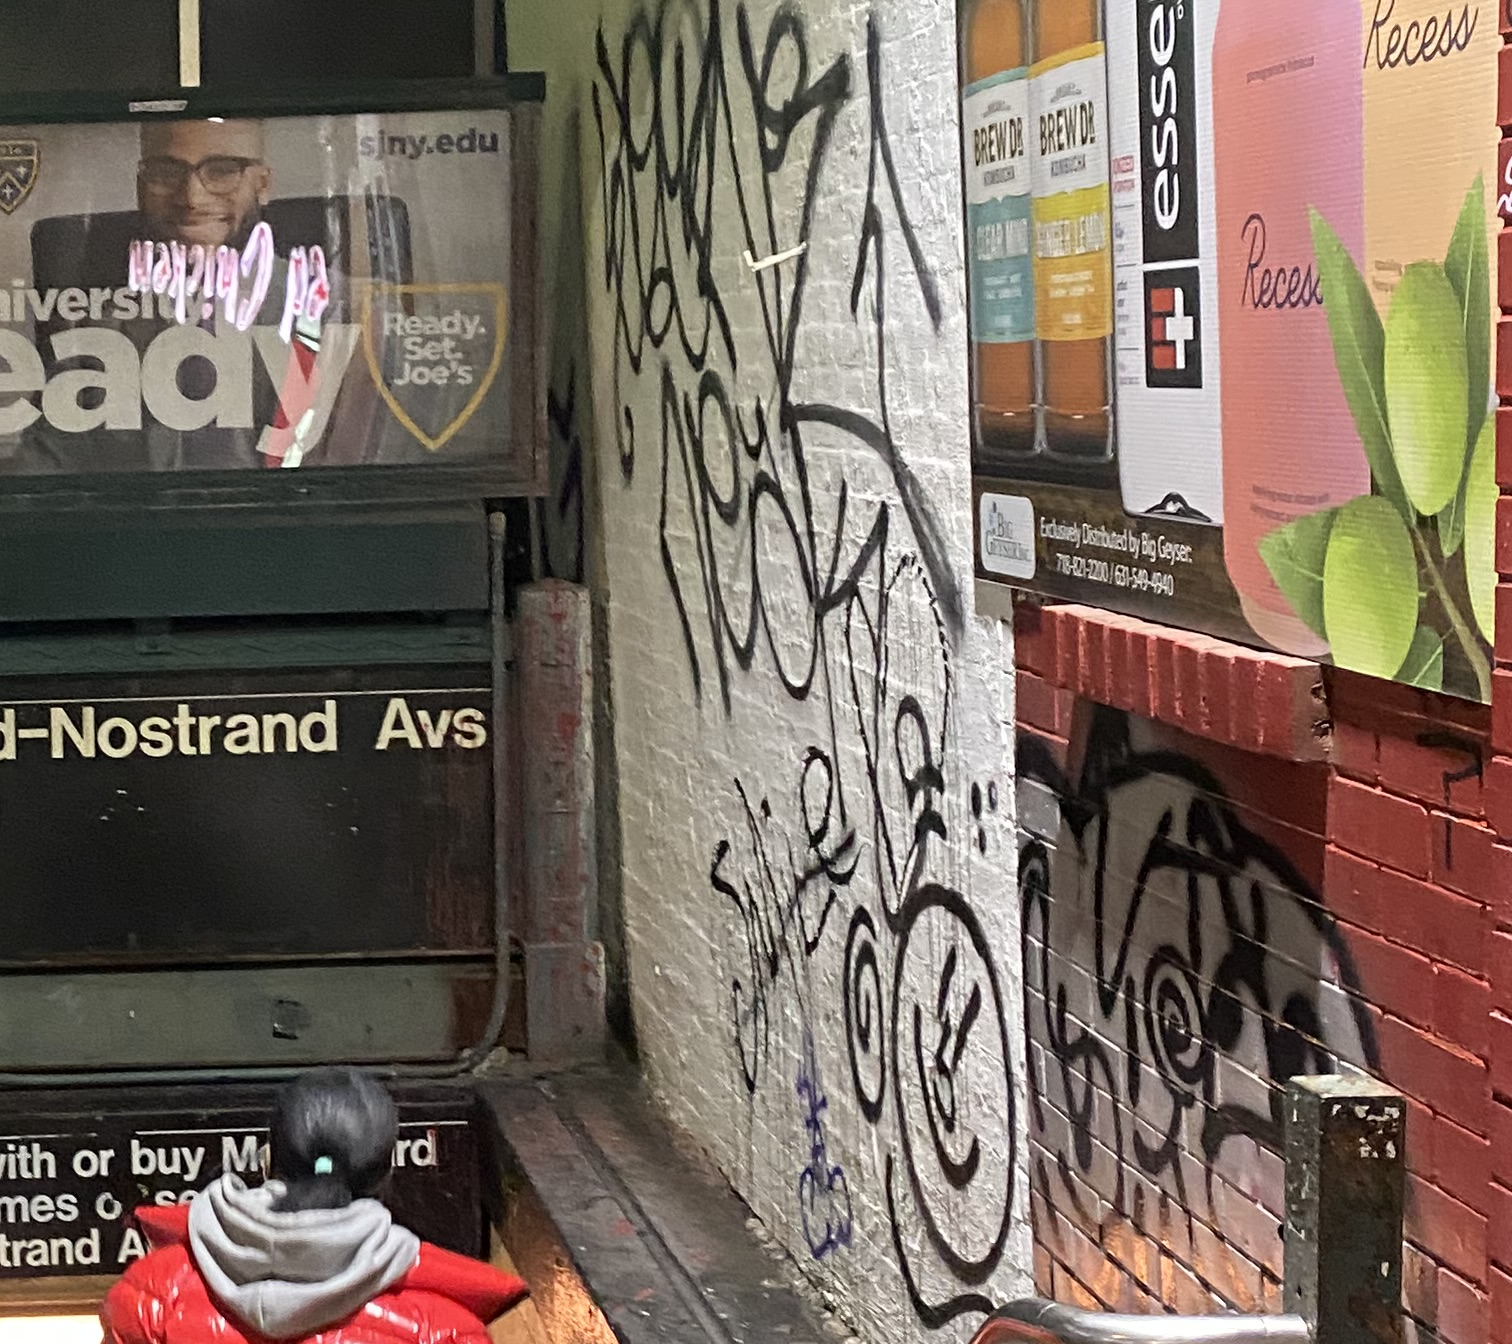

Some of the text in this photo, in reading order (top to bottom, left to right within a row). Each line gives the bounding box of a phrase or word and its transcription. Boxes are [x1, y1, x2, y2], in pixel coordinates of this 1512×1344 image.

[974, 121, 1008, 167] BREW
[1040, 105, 1079, 157] BREW
[384, 309, 486, 340] Ready.
[403, 336, 463, 360] Set.
[393, 360, 474, 385] Joe's
[1141, 532, 1157, 563] Big
[374, 698, 487, 752] Avs
[72, 1149, 115, 1178] or
[130, 1138, 206, 1182] buy
